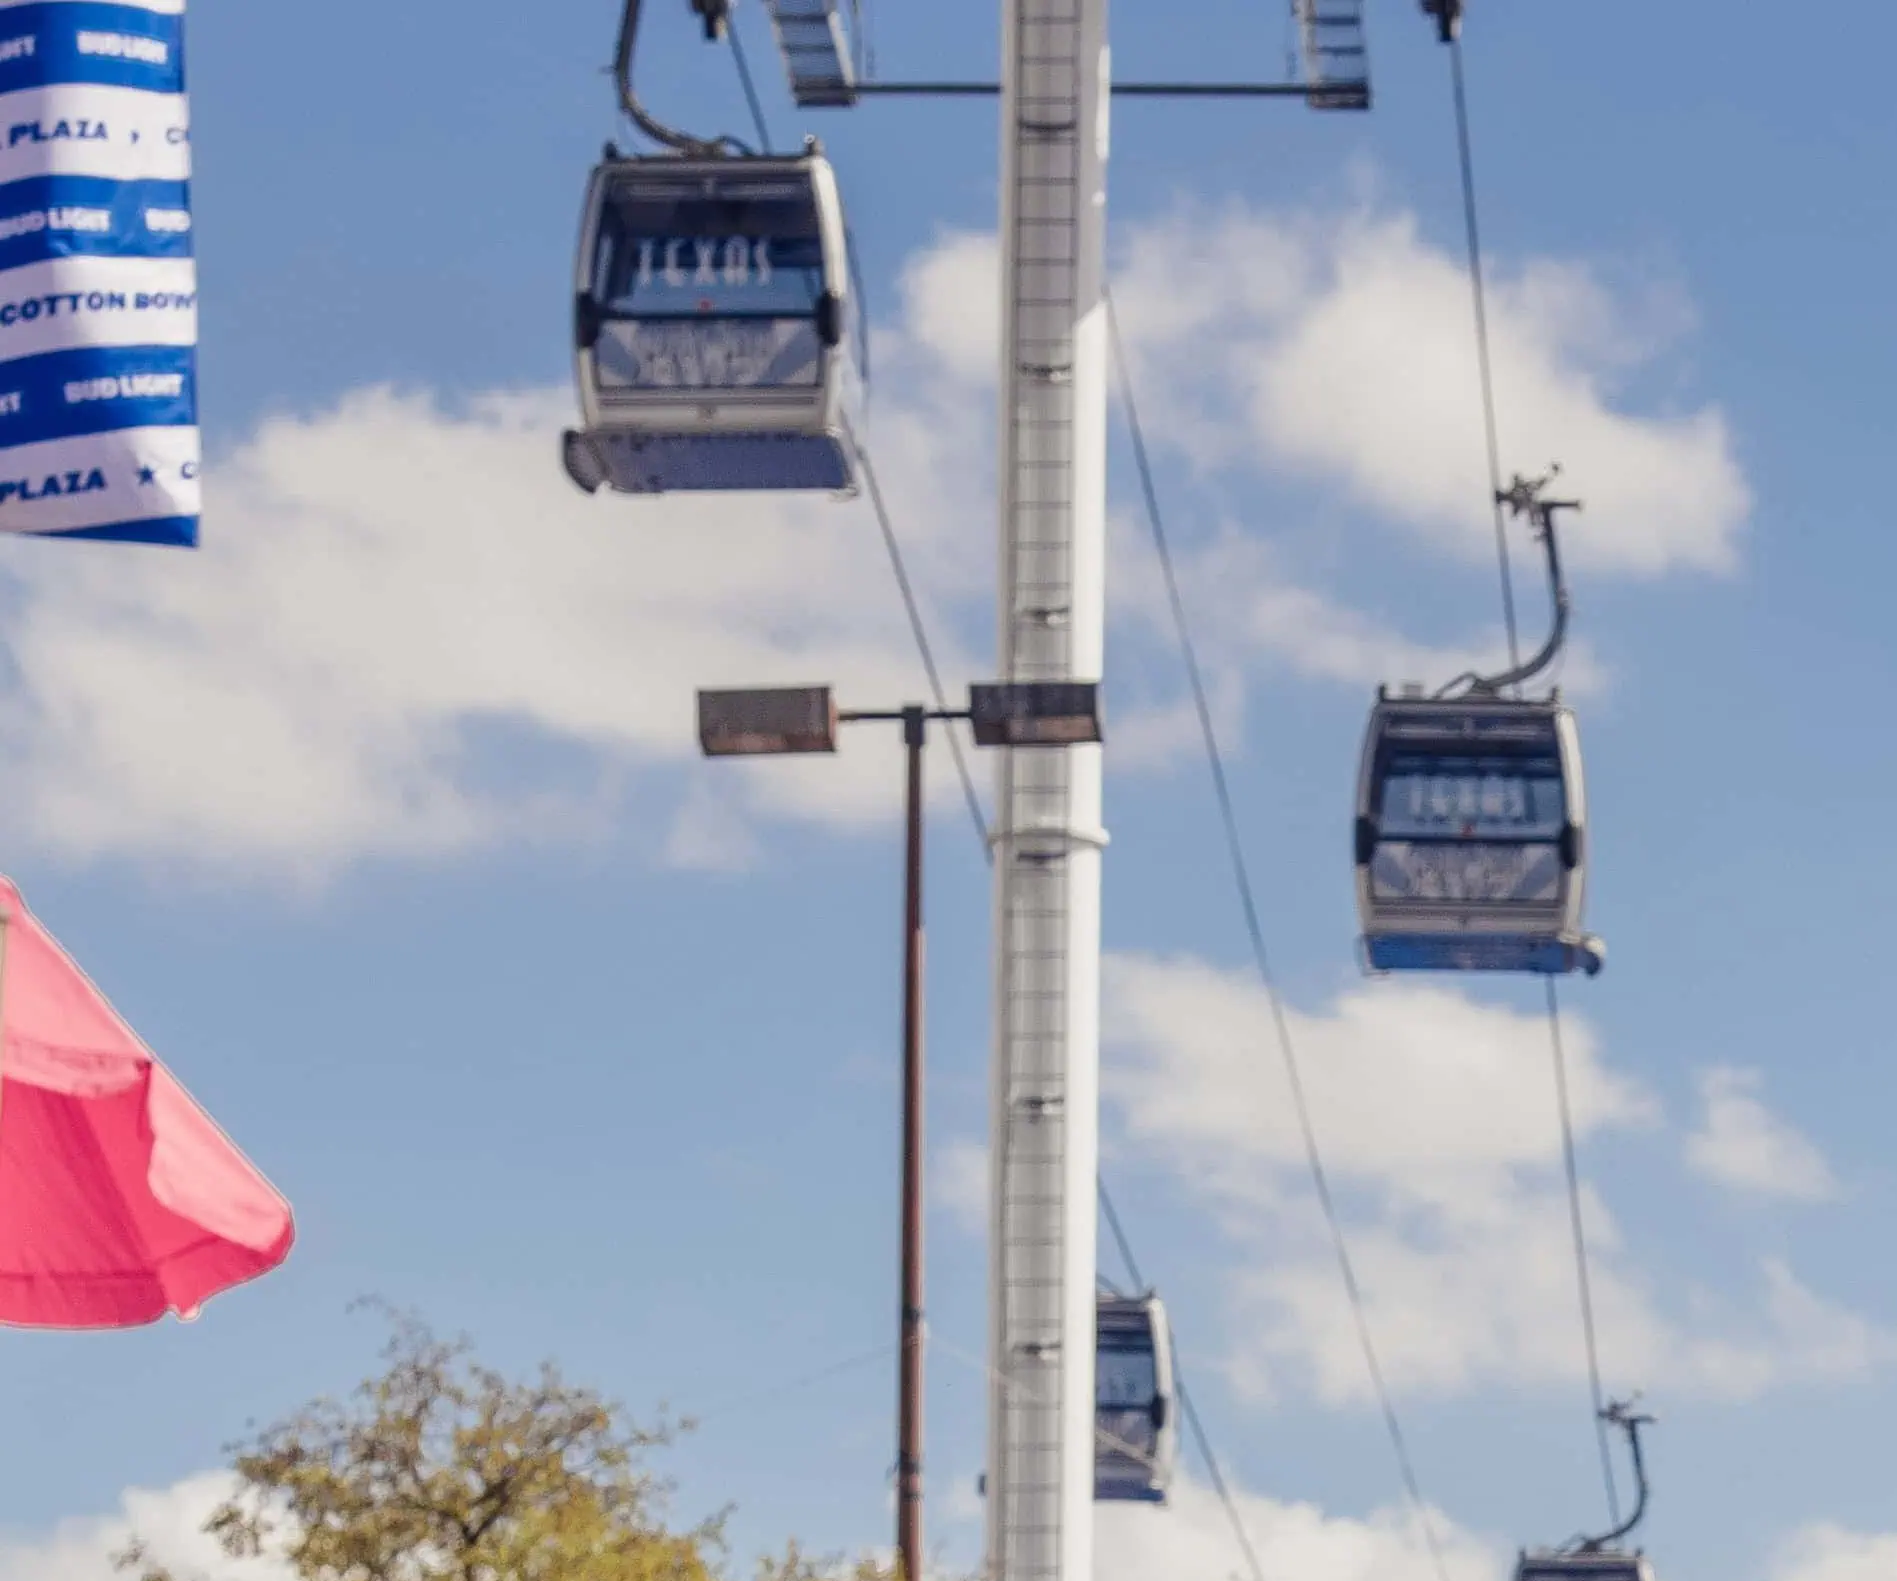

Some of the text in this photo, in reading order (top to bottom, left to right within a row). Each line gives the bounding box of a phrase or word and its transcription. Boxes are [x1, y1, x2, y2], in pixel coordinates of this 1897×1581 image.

[9, 119, 109, 148] PLAZA
[637, 235, 773, 288] TEXAS
[0, 291, 126, 326] COTTON
[0, 466, 108, 505] PLAZA
